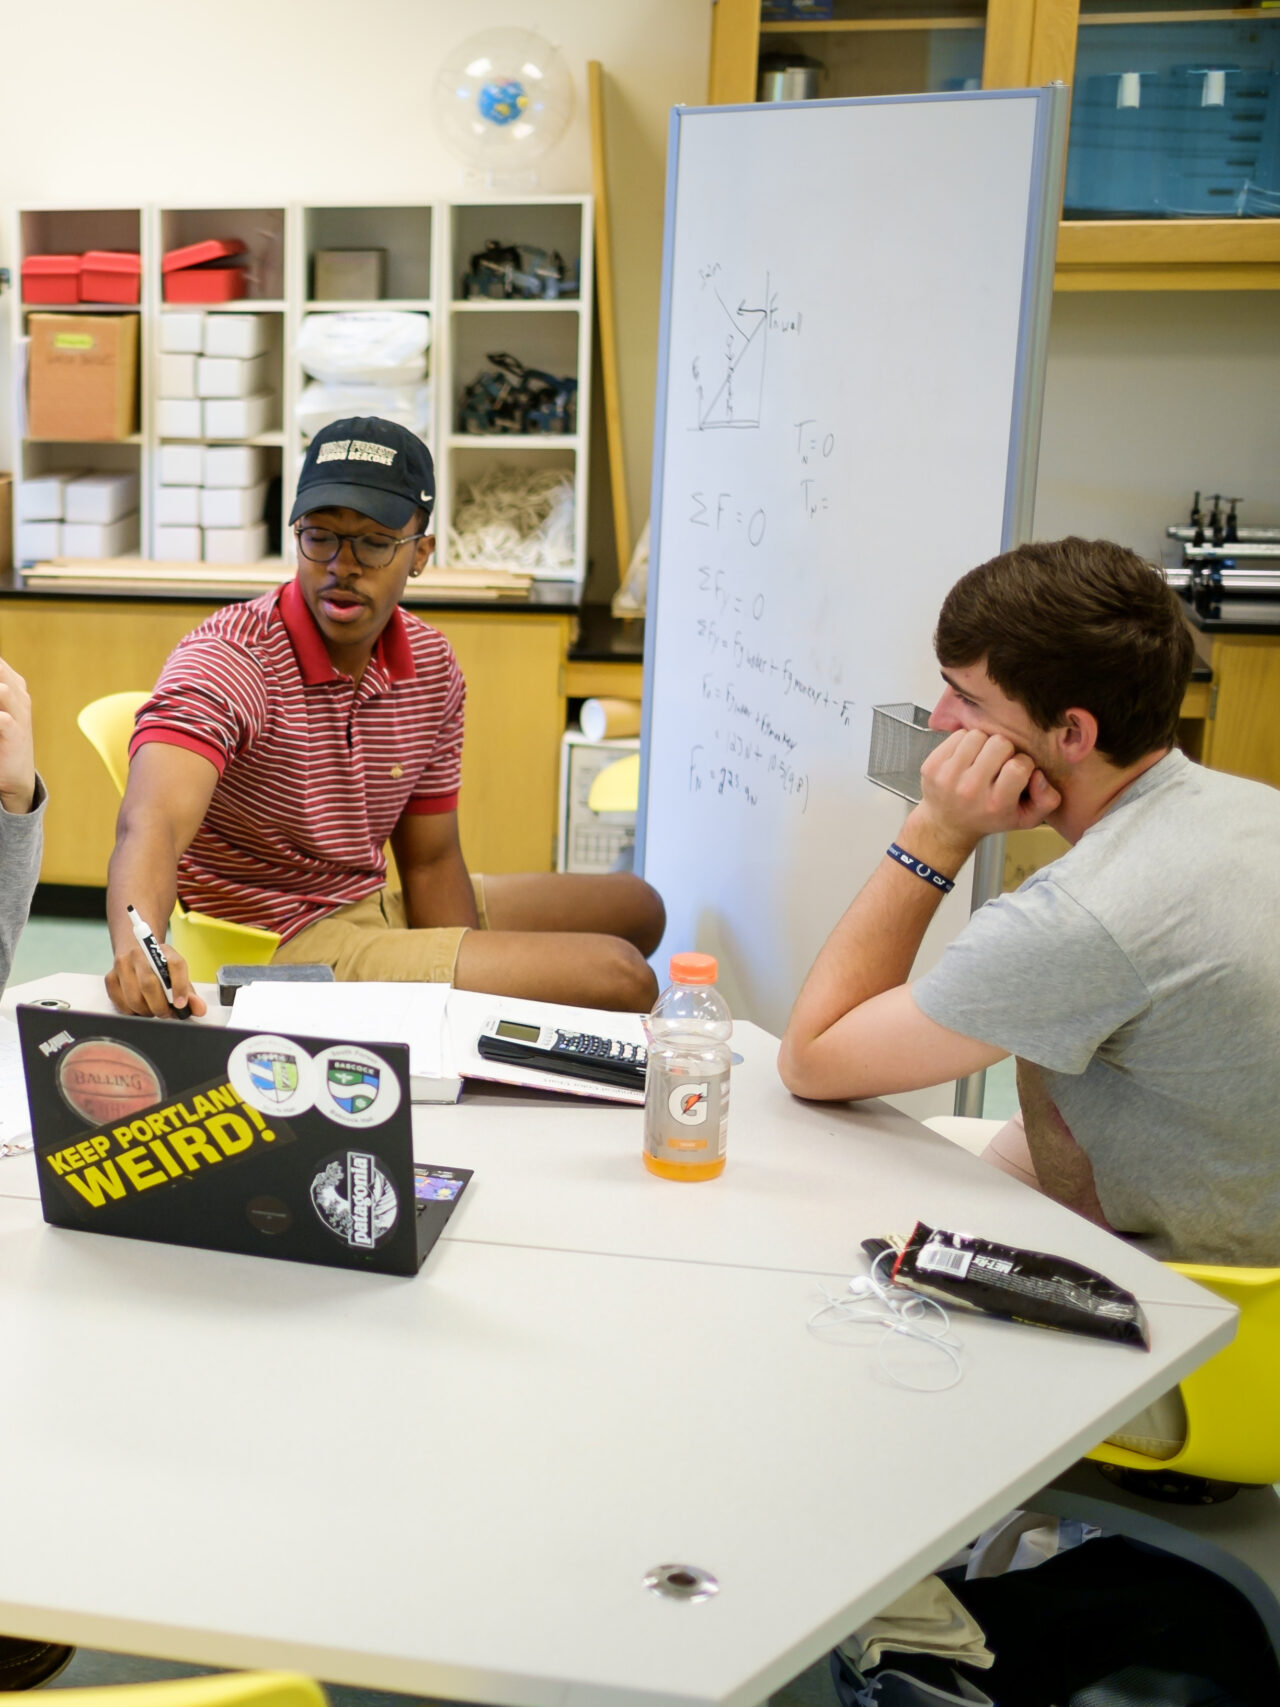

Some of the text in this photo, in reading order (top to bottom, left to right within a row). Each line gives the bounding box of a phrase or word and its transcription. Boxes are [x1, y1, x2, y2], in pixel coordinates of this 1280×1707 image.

[74, 1071, 142, 1091] BALLING
[334, 1061, 375, 1075] BABCOCK
[669, 1083, 708, 1126] G
[46, 1135, 111, 1176] KEEP
[65, 1102, 277, 1209] WEIRD!
[350, 1156, 372, 1245] patagonia
